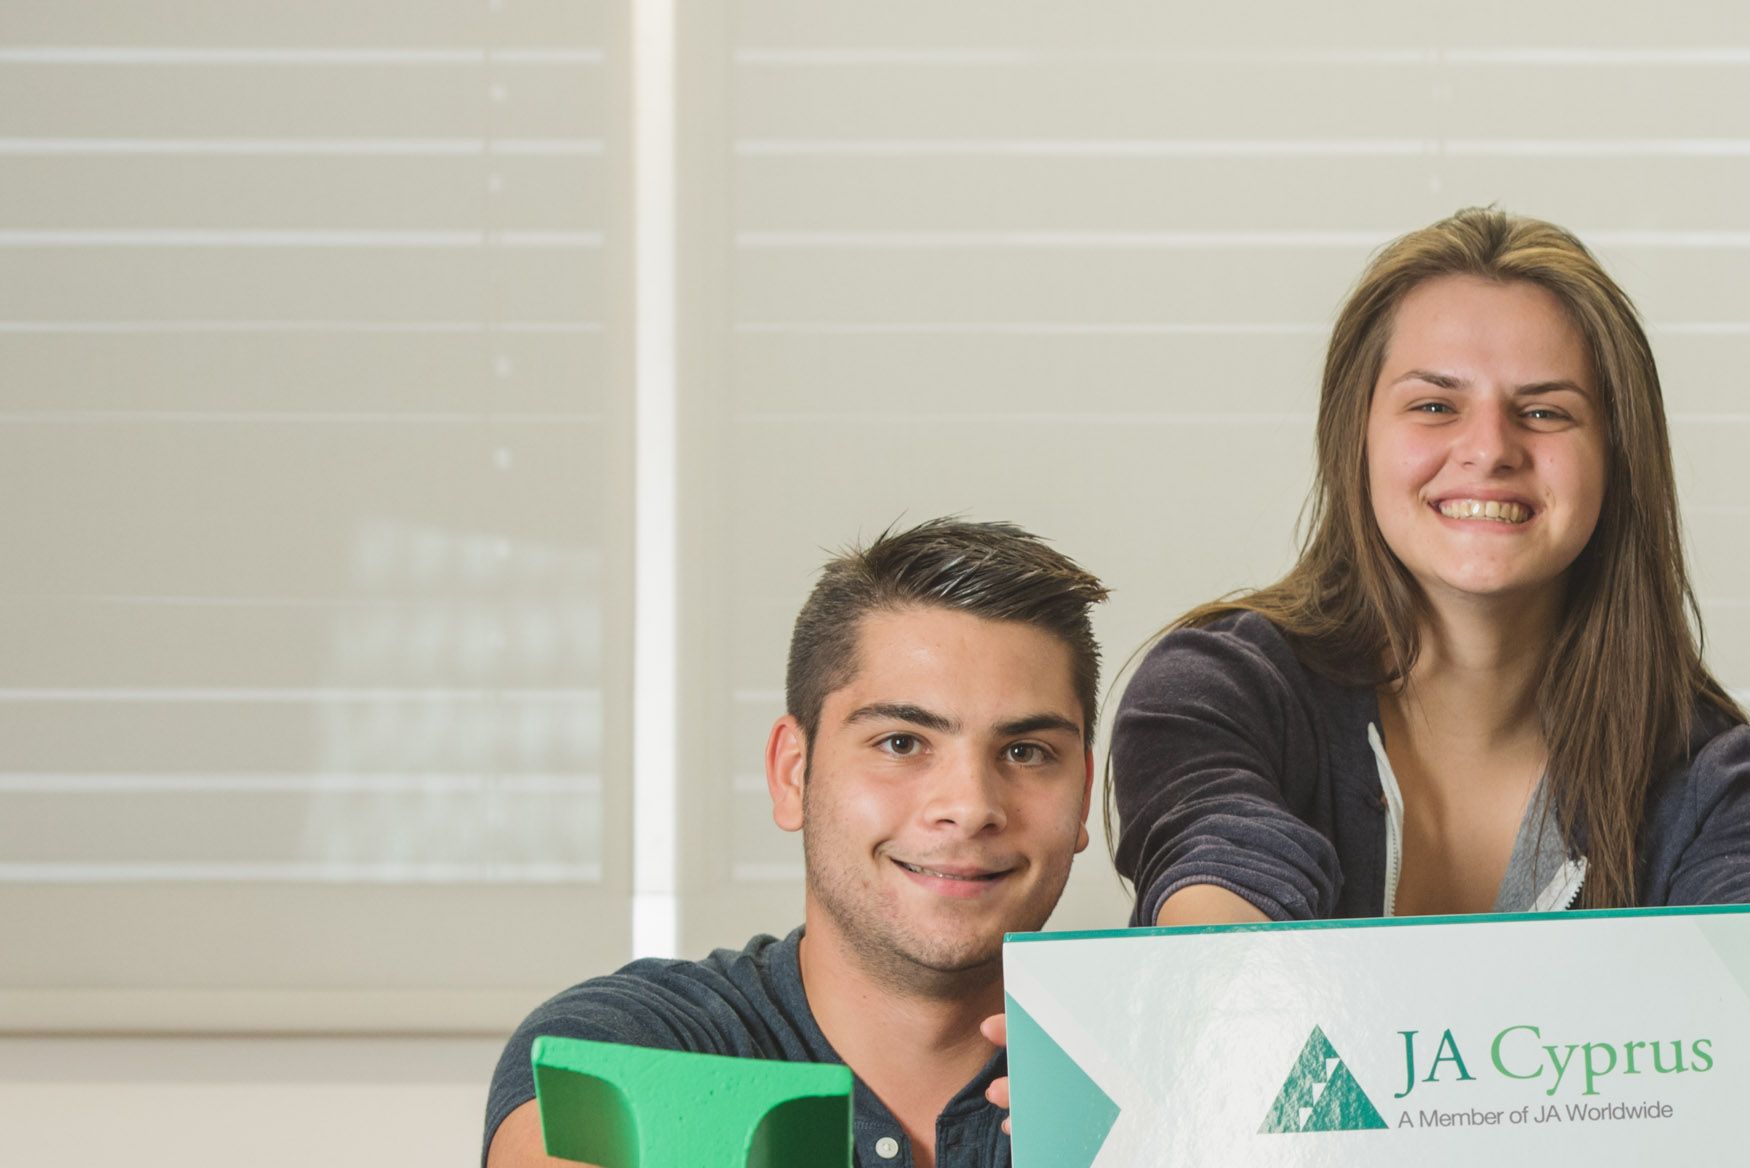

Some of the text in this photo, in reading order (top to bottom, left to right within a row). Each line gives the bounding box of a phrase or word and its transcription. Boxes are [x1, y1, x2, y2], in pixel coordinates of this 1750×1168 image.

[1394, 1025, 1714, 1099] JA Cyprus
[1398, 1100, 1674, 1129] A Member of JA Worldwide
